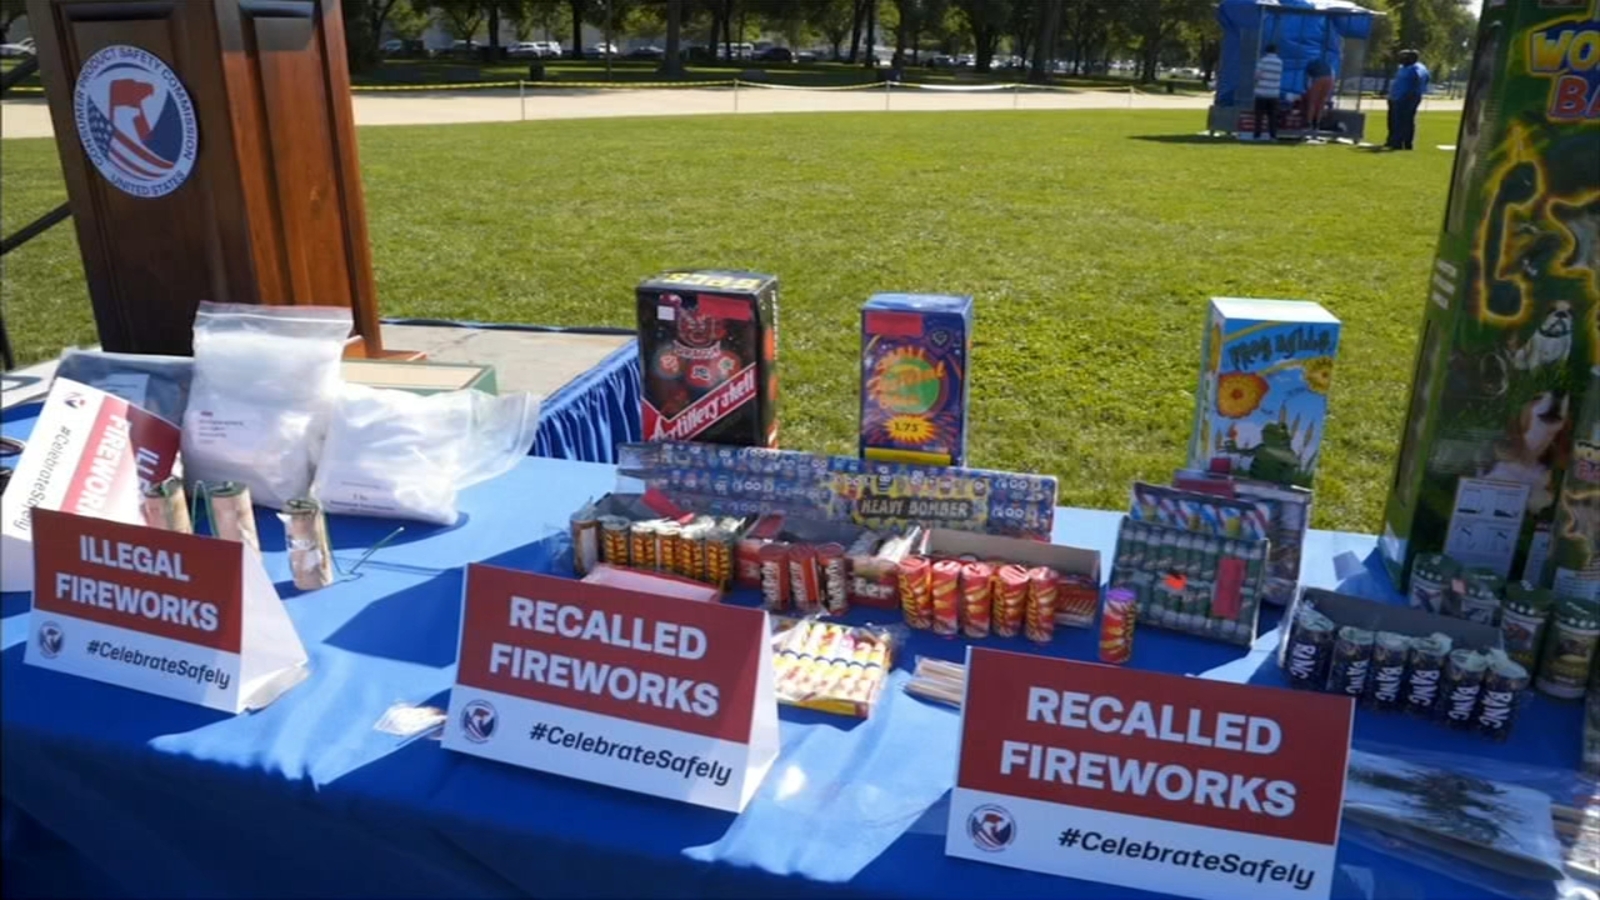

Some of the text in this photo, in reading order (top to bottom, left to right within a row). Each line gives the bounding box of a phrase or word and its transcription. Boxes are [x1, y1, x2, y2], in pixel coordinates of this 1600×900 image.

[76, 46, 197, 166] CONSUMER PRODUCT SAFETY COMMISSION
[110, 169, 186, 196] UNITED STATES
[75, 414, 133, 513] FIREWOR
[860, 498, 970, 518] HEAVY BOMBER
[79, 534, 191, 582] ILLEGAL
[55, 571, 219, 632] FIREWORKS
[508, 595, 708, 661] RECALLED
[86, 638, 231, 690] #CelebrateSafely
[489, 642, 720, 718] FIREWORKS
[529, 721, 732, 787] #CelebrateSafely
[1025, 686, 1283, 756] RECALLED
[1000, 739, 1297, 819] FIREWORKS
[1057, 827, 1316, 891] #CelebrateSafely
